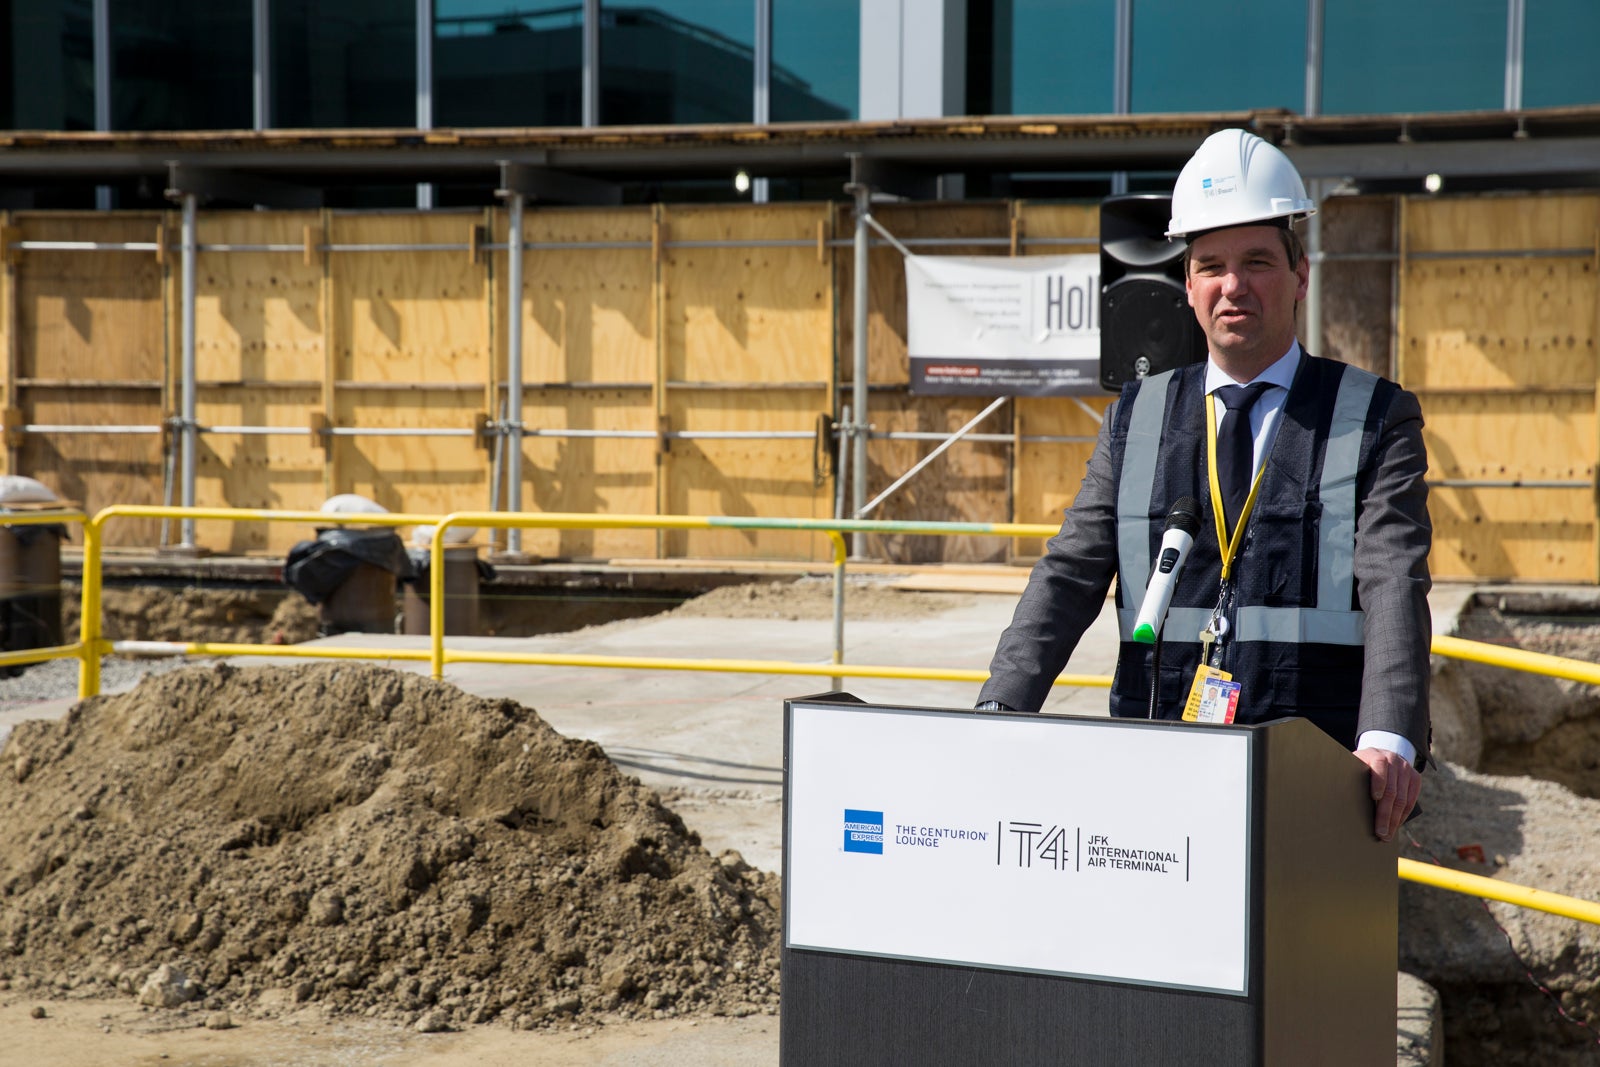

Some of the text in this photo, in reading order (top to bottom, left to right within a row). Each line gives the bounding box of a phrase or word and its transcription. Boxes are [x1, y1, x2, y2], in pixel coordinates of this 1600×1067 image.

[844, 823, 881, 832] AMERICAN
[896, 825, 987, 841] THE CENTURION
[851, 833, 883, 842] EXPRESS
[896, 835, 940, 848] LOUNGE
[1087, 835, 1109, 846] JFK
[1009, 821, 1069, 871] T4
[1088, 846, 1180, 864] INTERNATIONAL
[1087, 857, 1169, 874] AIR TERMINAL
